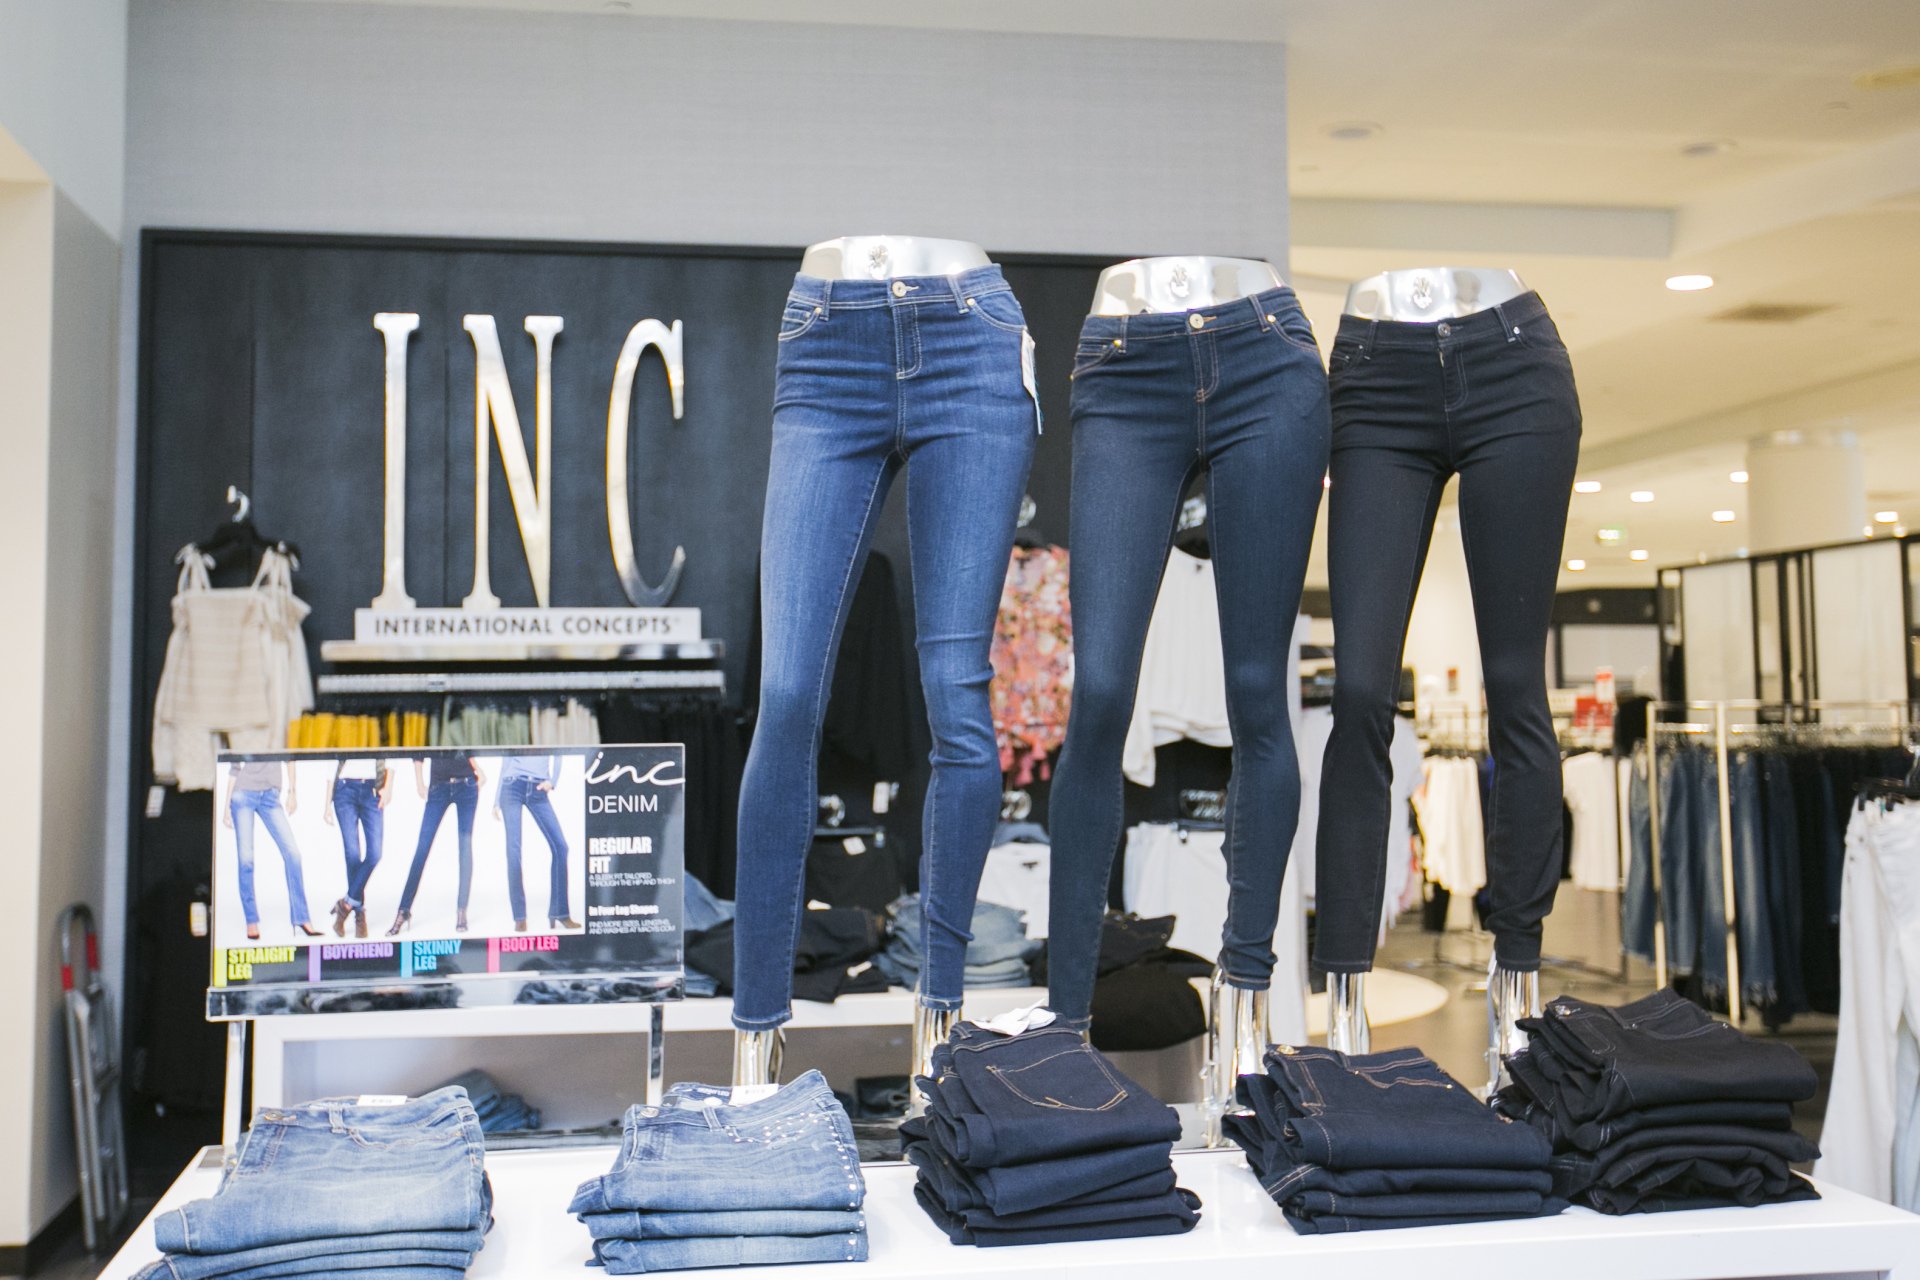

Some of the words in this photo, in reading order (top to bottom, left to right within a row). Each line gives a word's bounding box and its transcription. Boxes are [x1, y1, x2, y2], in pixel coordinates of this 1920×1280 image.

[372, 312, 686, 608] INC
[375, 617, 551, 634] INTERNATIONAL
[563, 616, 672, 634] CONCEPTS
[585, 751, 686, 785] inc
[589, 794, 658, 813] DENIM
[589, 836, 652, 855] REGULAR
[589, 856, 611, 874] FIT
[323, 943, 393, 960] BOYFRIEND
[414, 939, 462, 956] SKINNY
[501, 937, 536, 952] BOOT
[536, 935, 560, 951] LEG
[228, 947, 296, 964] STRAIGHT
[414, 955, 437, 971] LEG
[228, 963, 252, 981] LEG
